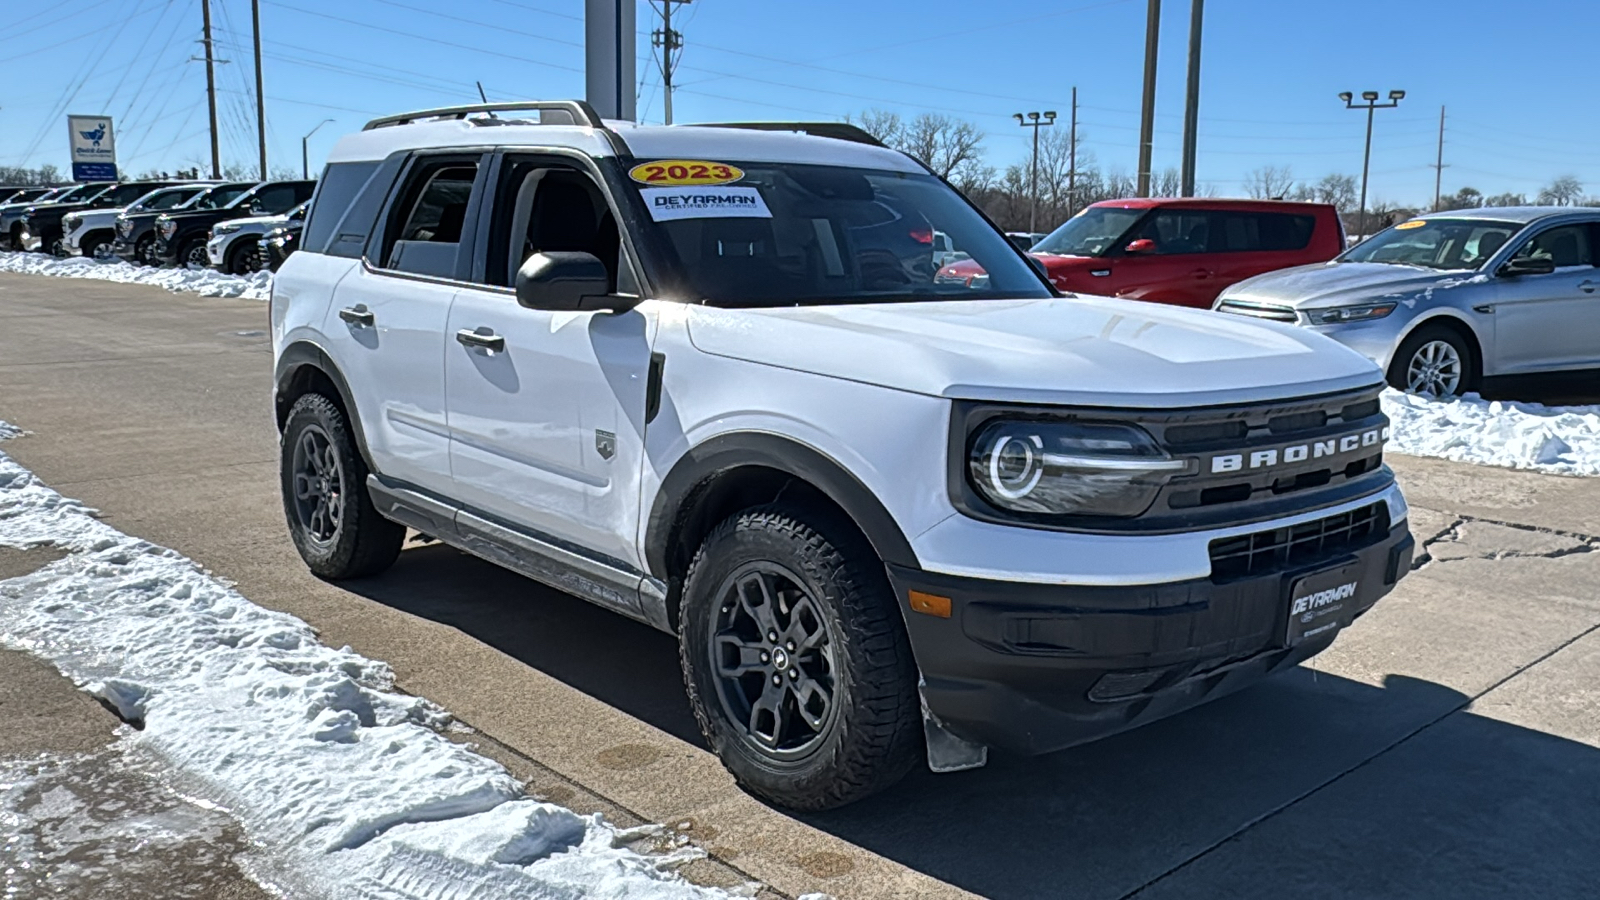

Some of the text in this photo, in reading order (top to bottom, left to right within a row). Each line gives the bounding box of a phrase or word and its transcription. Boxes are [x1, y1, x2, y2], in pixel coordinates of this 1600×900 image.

[645, 165, 733, 181] 2023
[654, 195, 755, 206] DEYARMAN
[1211, 429, 1378, 473] BRONCO
[1292, 581, 1358, 616] DEYARMAN
